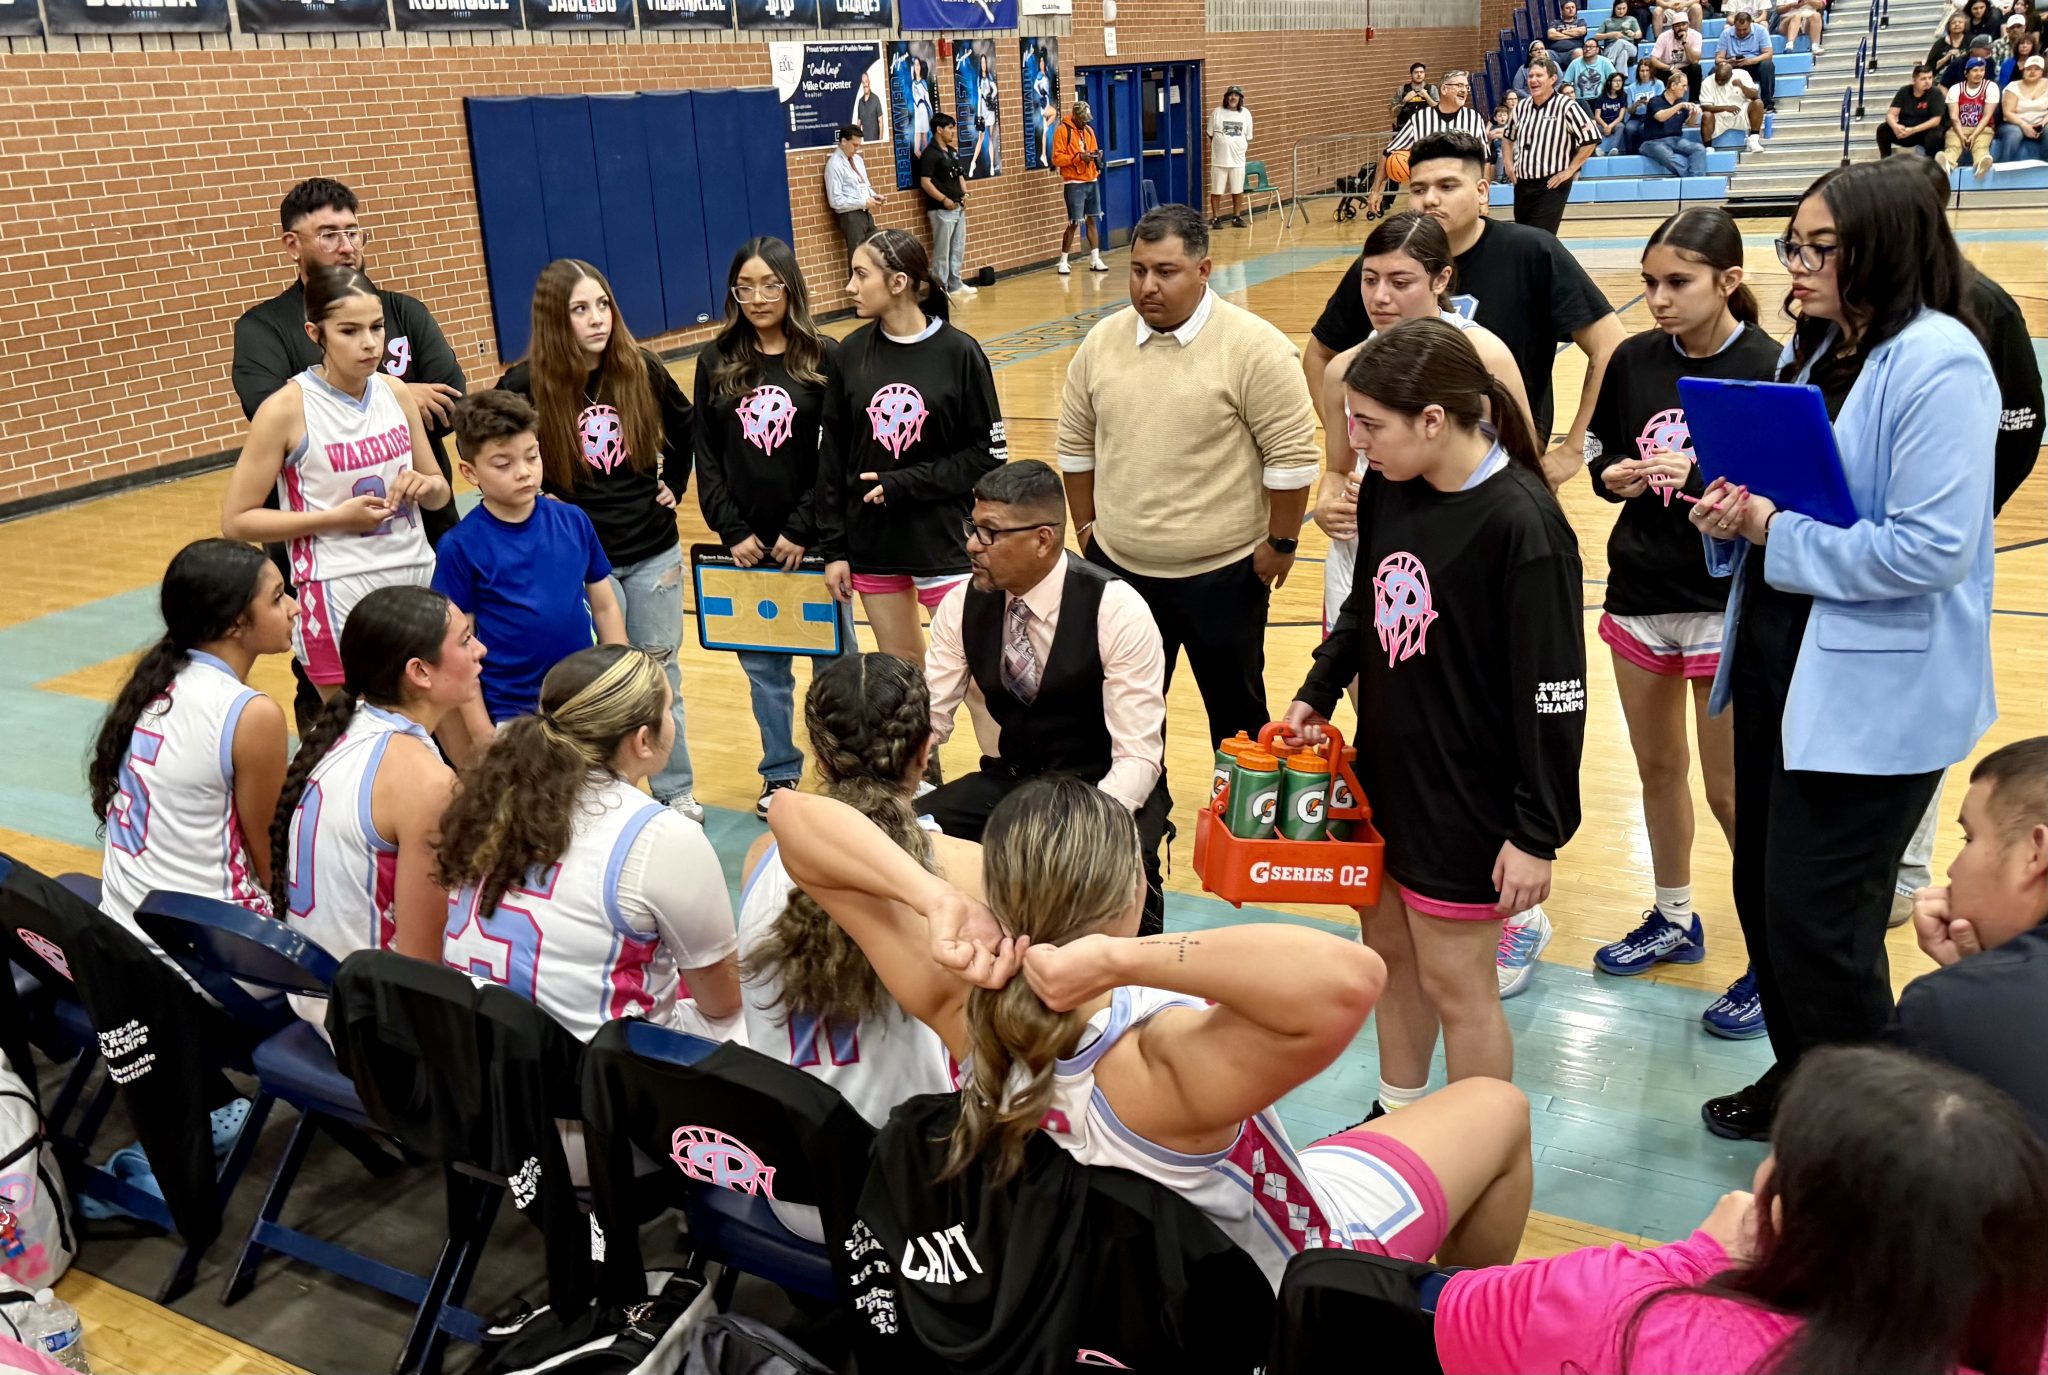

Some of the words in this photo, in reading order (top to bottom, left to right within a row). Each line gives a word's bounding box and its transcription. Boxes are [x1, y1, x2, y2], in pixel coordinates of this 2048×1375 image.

[802, 81, 818, 91] Mike
[819, 80, 851, 92] Carpenter
[324, 423, 412, 473] WARRIORS
[1538, 678, 1581, 692] 2025-26
[1551, 688, 1585, 702] Region
[1537, 699, 1584, 714] CHAMPS
[1252, 790, 1278, 824] G
[1297, 790, 1325, 824] G
[1339, 865, 1369, 887] 02
[108, 1025, 150, 1048] Region
